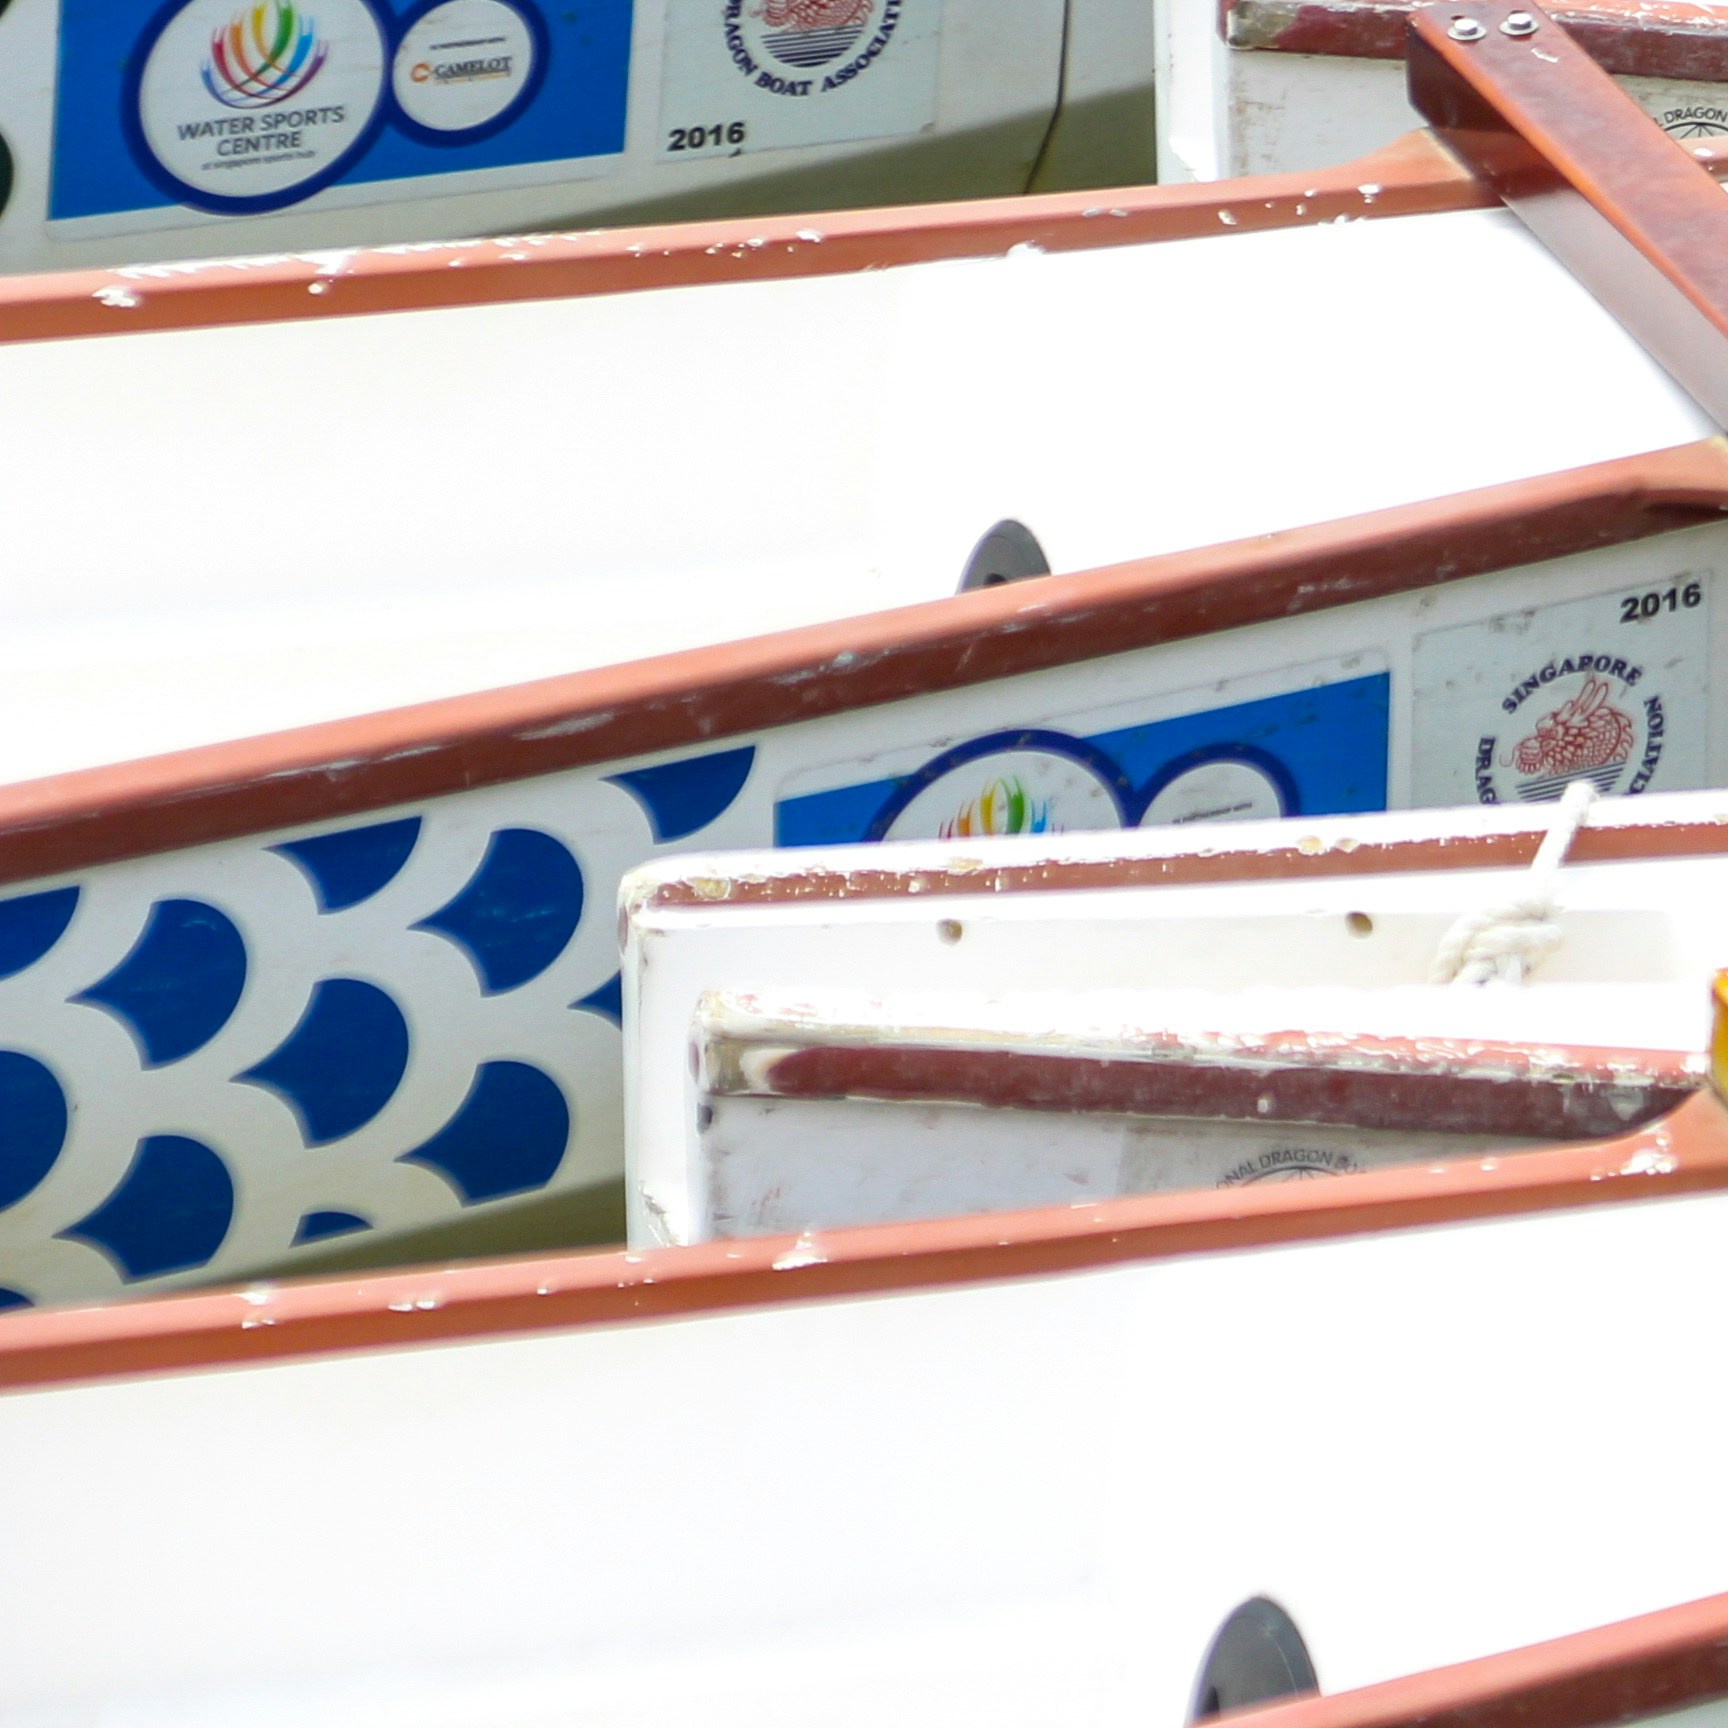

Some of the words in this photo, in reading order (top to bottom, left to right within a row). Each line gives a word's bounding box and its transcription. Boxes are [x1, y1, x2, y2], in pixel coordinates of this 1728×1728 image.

[754, 71, 813, 97] BOAT
[177, 116, 254, 141] WATER
[260, 106, 345, 132] SPORTS
[1663, 106, 1728, 125] DRAGON
[217, 131, 302, 157] CENTRE
[667, 121, 746, 152] 2016
[1619, 582, 1701, 623] 2016
[1501, 654, 1643, 714] SINGAPORE
[1475, 736, 1499, 804] DRAG
[1258, 1148, 1333, 1170] DRAGON
